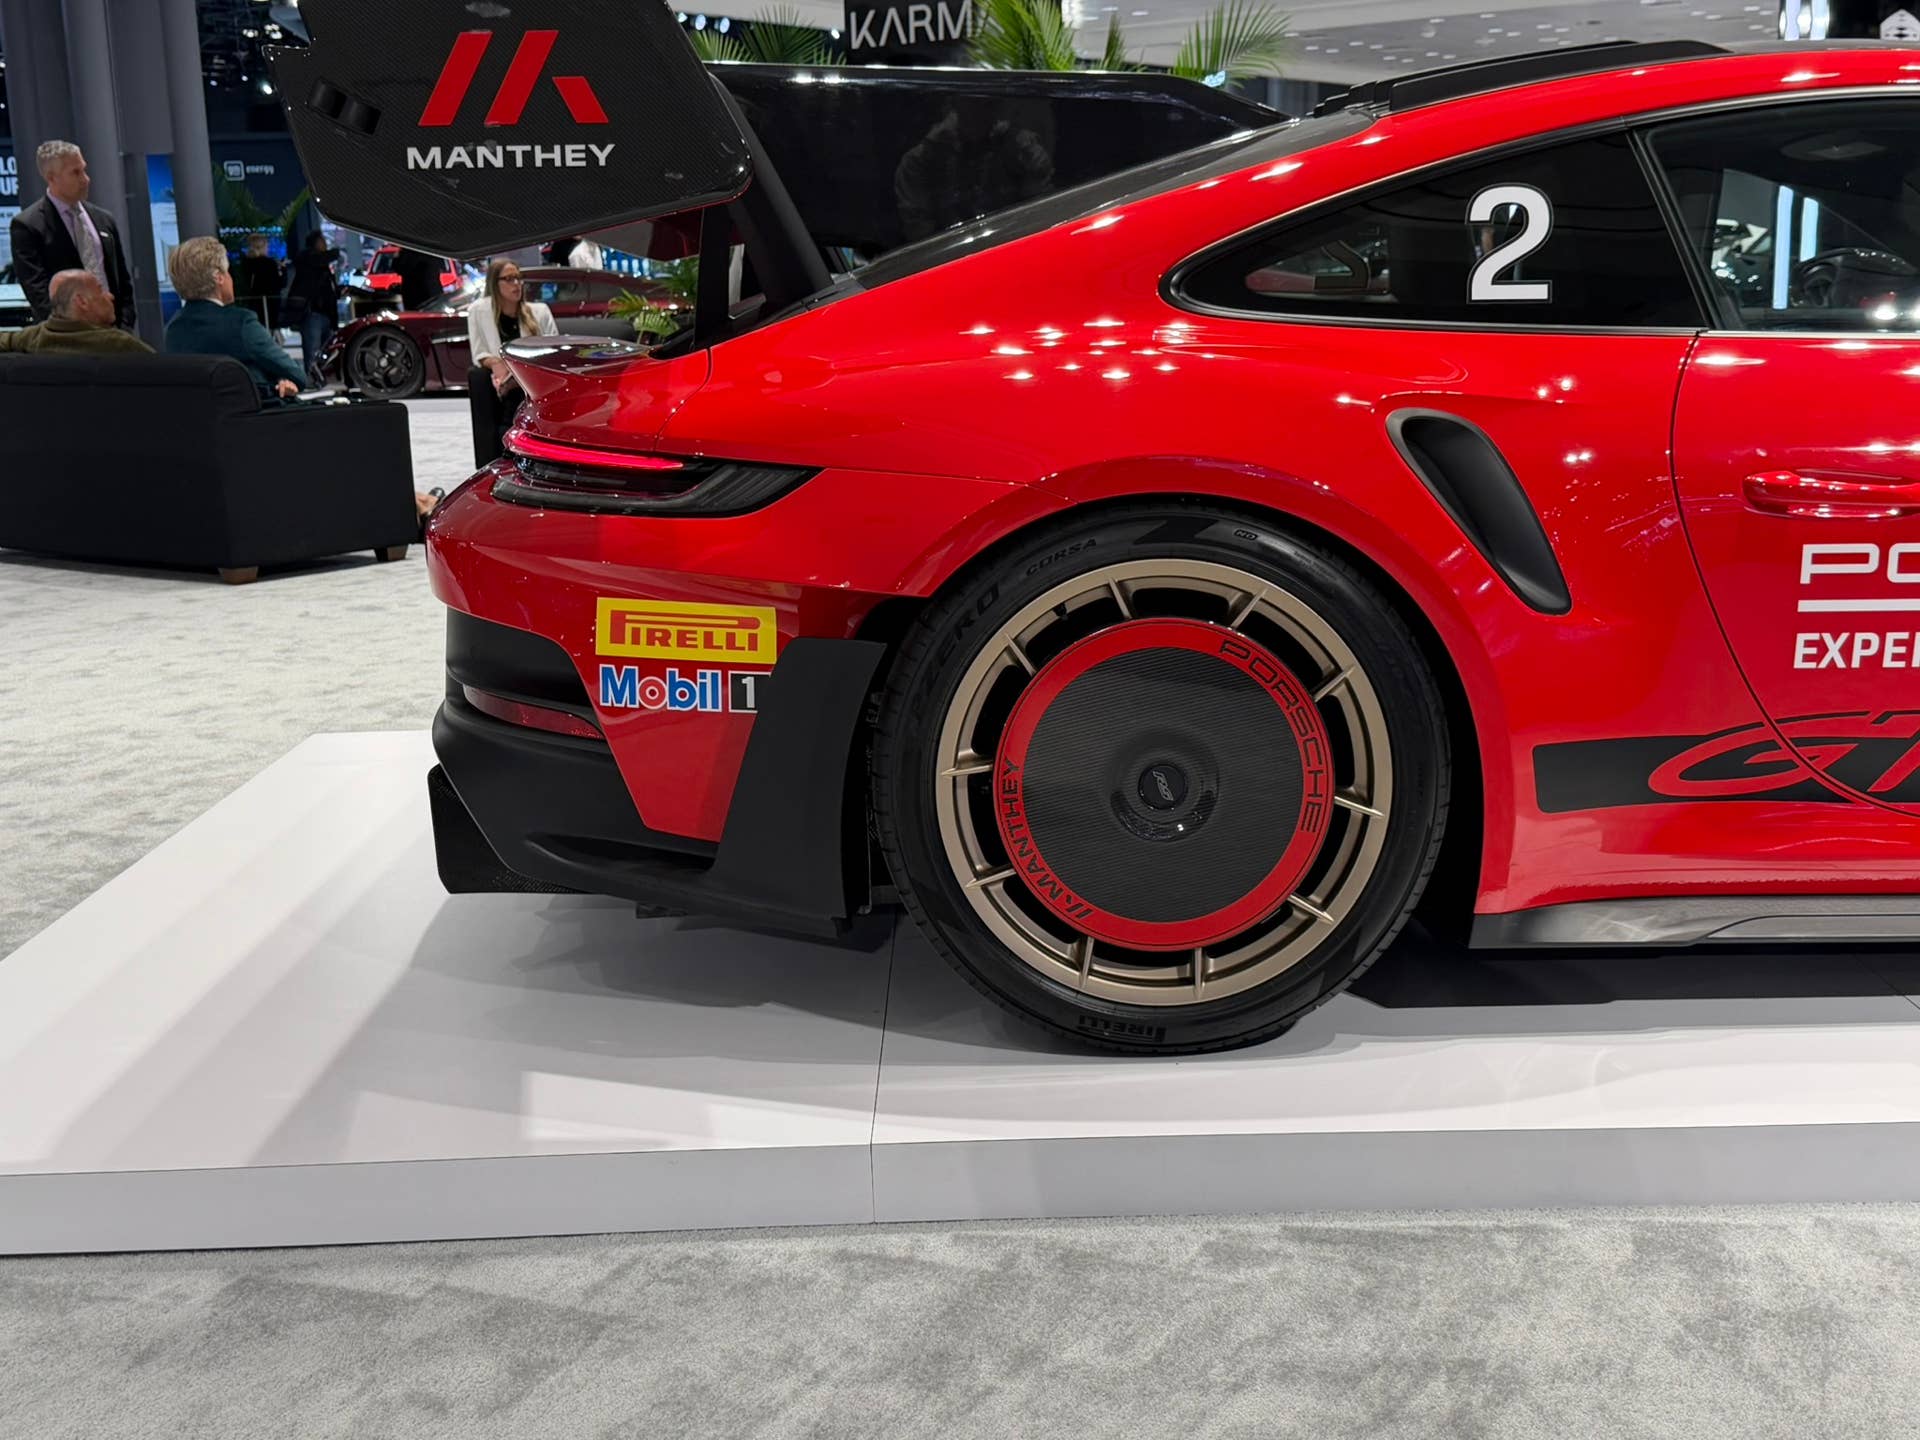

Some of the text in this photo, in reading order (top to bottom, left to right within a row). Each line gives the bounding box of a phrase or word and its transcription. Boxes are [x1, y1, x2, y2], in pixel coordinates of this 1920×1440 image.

[406, 143, 616, 170] MANTHEY
[1466, 183, 1553, 303] 2
[1026, 538, 1097, 577] CORSA
[610, 609, 761, 652] PIRELLI
[599, 663, 722, 712] Mobil
[1220, 640, 1325, 833] PORSCHE
[1001, 758, 1065, 901] MANTHEY
[1077, 1014, 1168, 1043] PIRELLI
